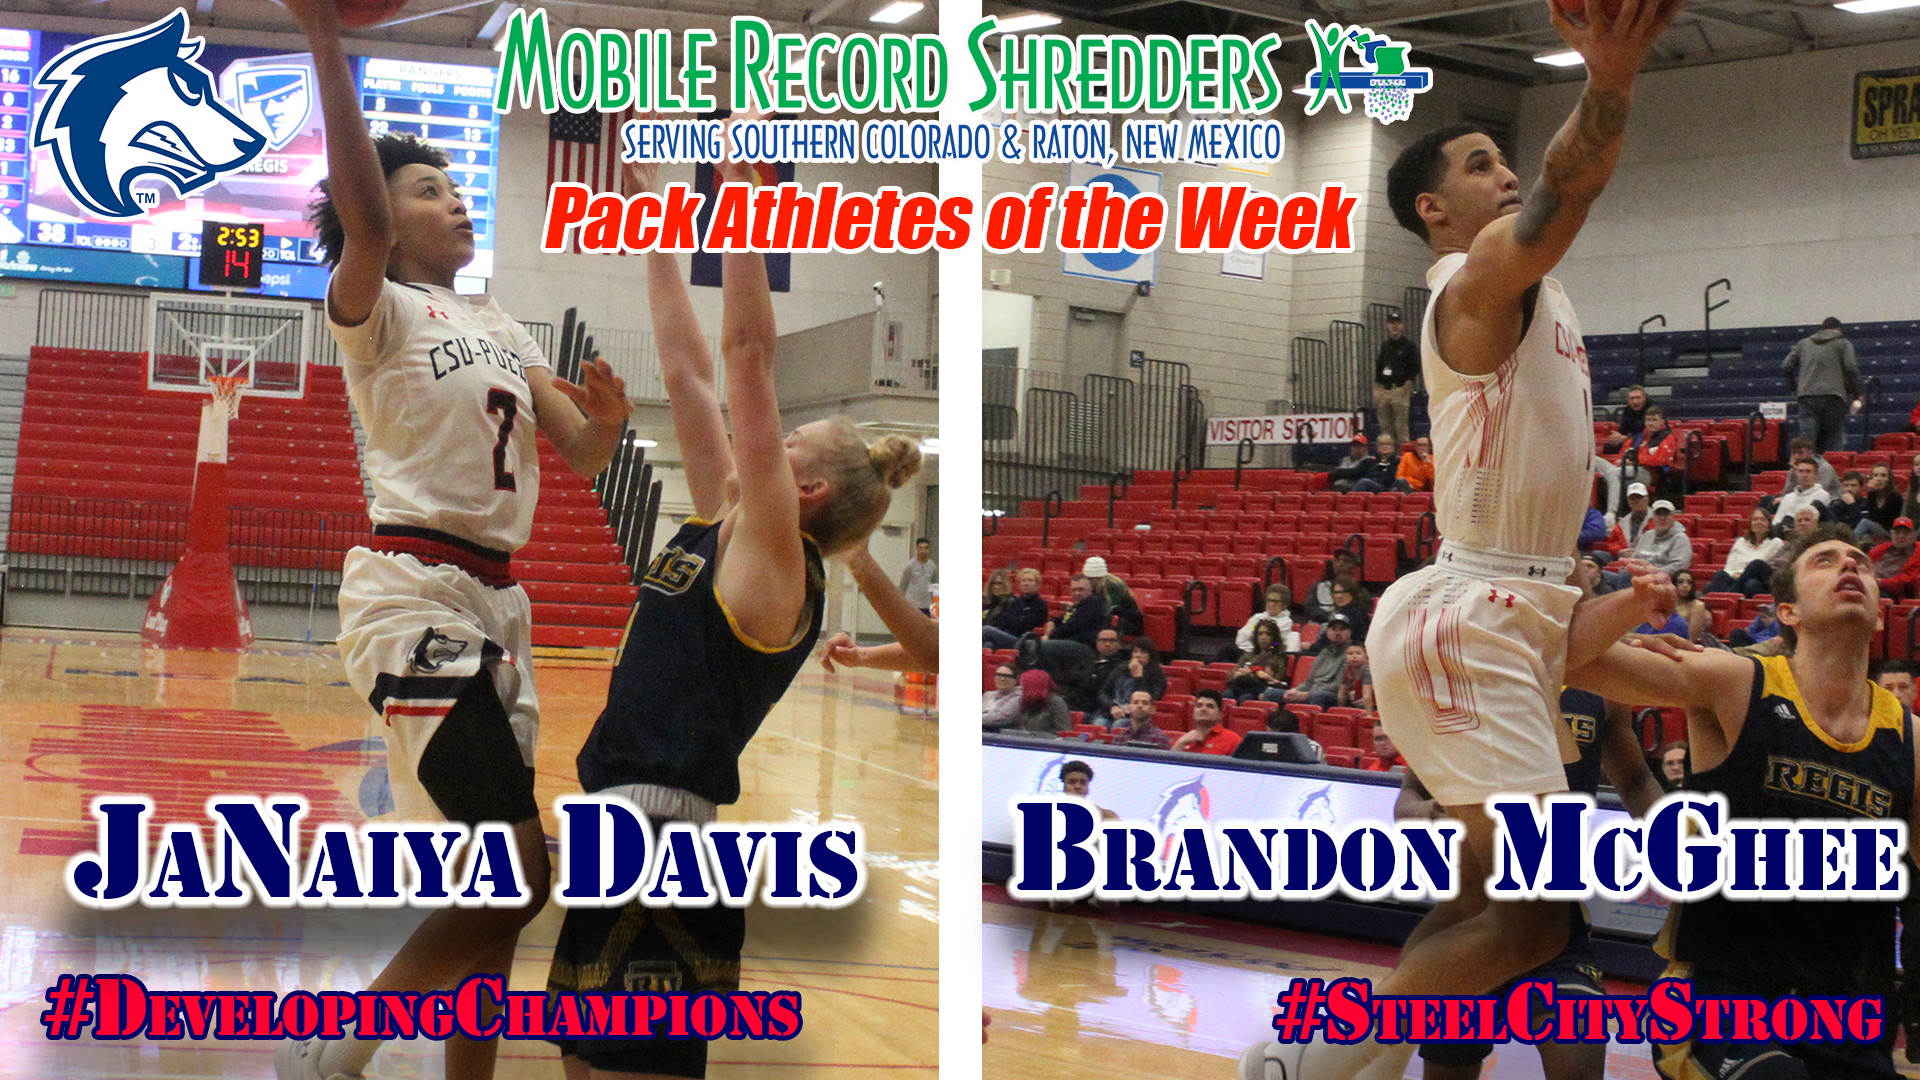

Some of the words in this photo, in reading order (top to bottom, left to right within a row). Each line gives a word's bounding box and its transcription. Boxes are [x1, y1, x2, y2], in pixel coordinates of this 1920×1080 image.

[1, 68, 20, 83] 16
[400, 65, 462, 79] RANGERS
[363, 78, 402, 91] PLAYER
[411, 82, 445, 95] FOULS
[453, 85, 492, 99] POINTS
[375, 97, 386, 111] 5
[420, 101, 432, 115] 0
[468, 105, 479, 119] 5
[1, 115, 13, 129] 2
[369, 120, 389, 135] 22
[420, 124, 429, 138] 1
[463, 127, 481, 142] 13
[465, 150, 477, 164] 9
[464, 173, 476, 186] 7
[37, 222, 66, 243] 38
[217, 227, 260, 248] 2:53
[224, 250, 250, 279] 14
[486, 387, 517, 493] 2
[1209, 419, 1275, 442] VISITOR
[1764, 756, 1893, 822] REGIS
